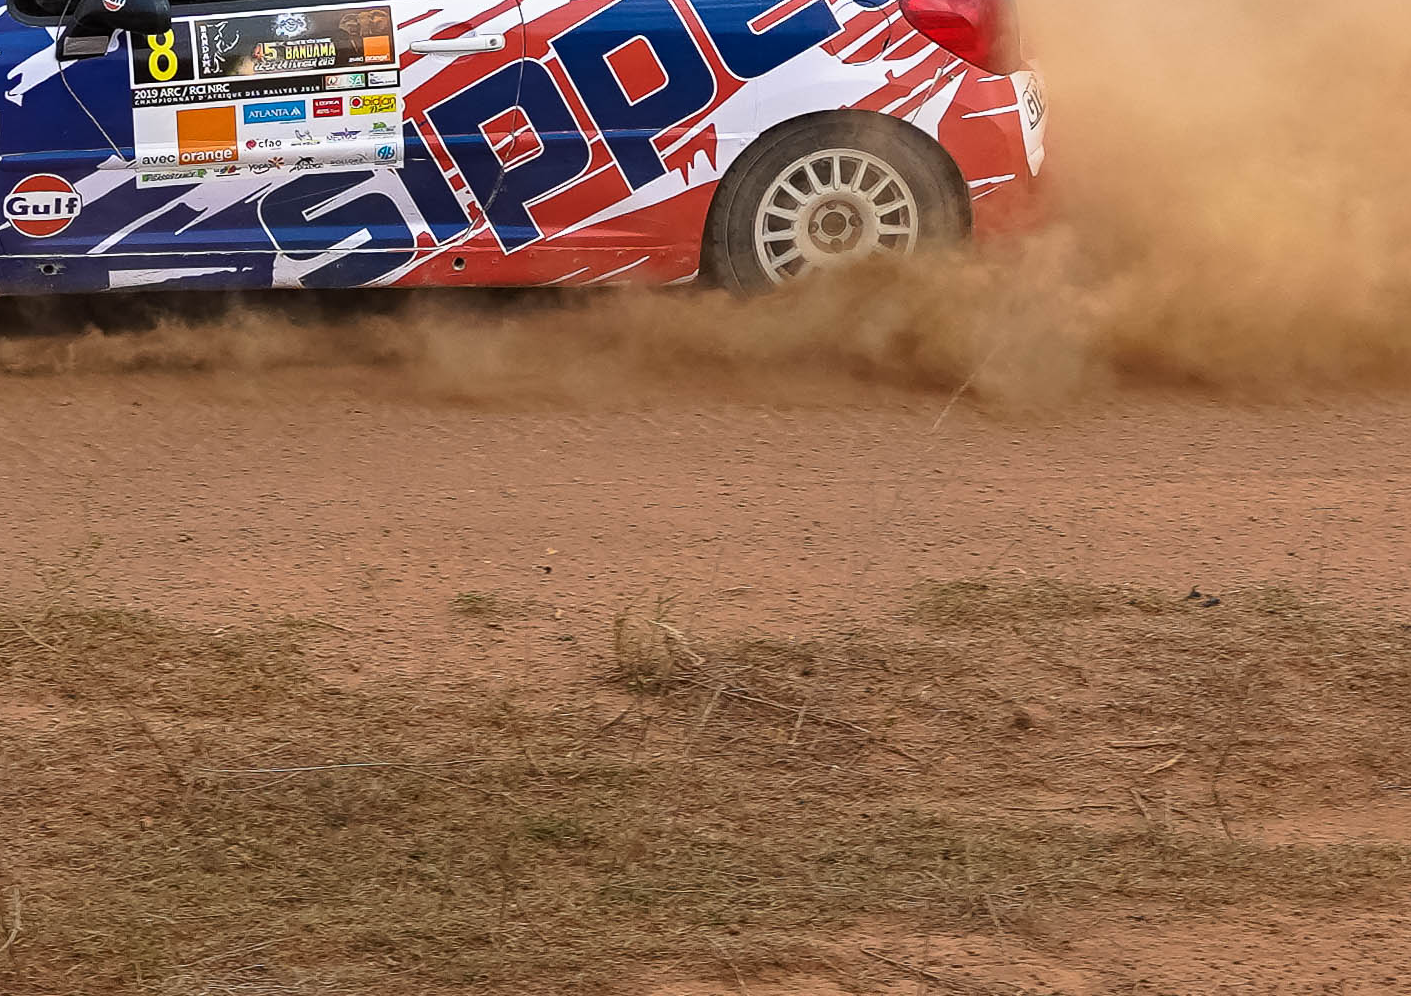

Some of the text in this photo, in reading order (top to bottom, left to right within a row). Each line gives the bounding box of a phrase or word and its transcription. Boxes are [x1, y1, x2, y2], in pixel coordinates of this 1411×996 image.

[147, 29, 178, 81] 8
[285, 42, 337, 60] BANDAMA
[134, 89, 158, 100] 2019
[160, 87, 182, 97] ARC
[182, 86, 188, 97] /
[208, 84, 230, 93] NRC
[134, 95, 194, 106] CHAMPIONNAT
[198, 91, 243, 101] D'AFRIQUE
[248, 108, 290, 119] ATLANTA
[258, 138, 282, 148] cfao
[141, 148, 233, 165] avec orange
[5, 196, 79, 216] Gulf
